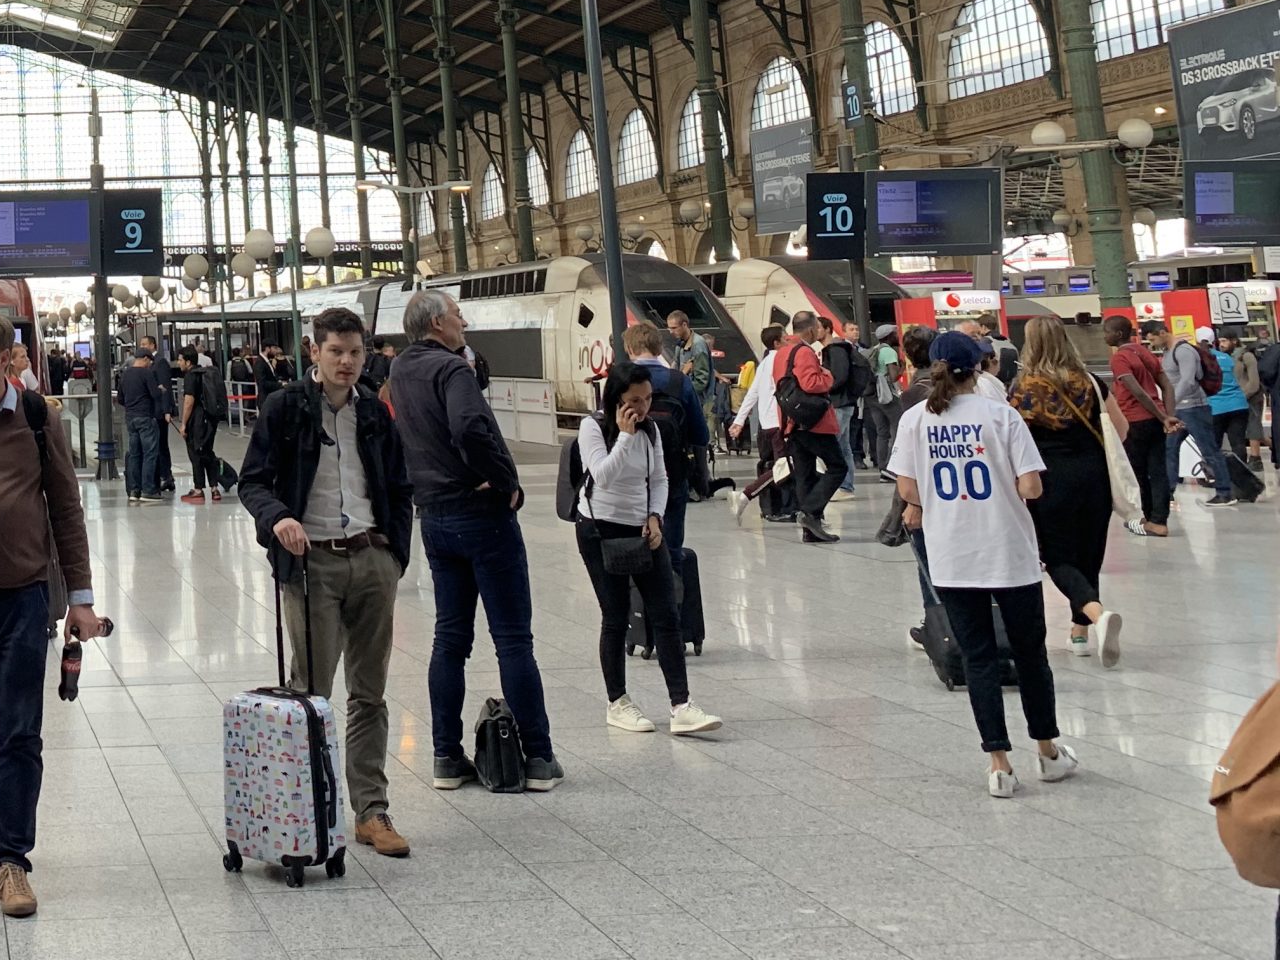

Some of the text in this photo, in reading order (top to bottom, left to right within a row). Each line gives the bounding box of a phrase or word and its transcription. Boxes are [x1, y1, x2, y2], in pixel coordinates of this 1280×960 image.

[1182, 71, 1194, 86] DS
[1195, 70, 1201, 83] 3
[1202, 55, 1259, 81] CROSSBACK
[847, 95, 859, 116] 10
[819, 206, 853, 232] 10
[125, 222, 143, 249] 9
[963, 295, 991, 304] selecta
[927, 425, 982, 443] HAPPY
[929, 444, 974, 459] HOURS
[933, 460, 992, 501] 0.0
